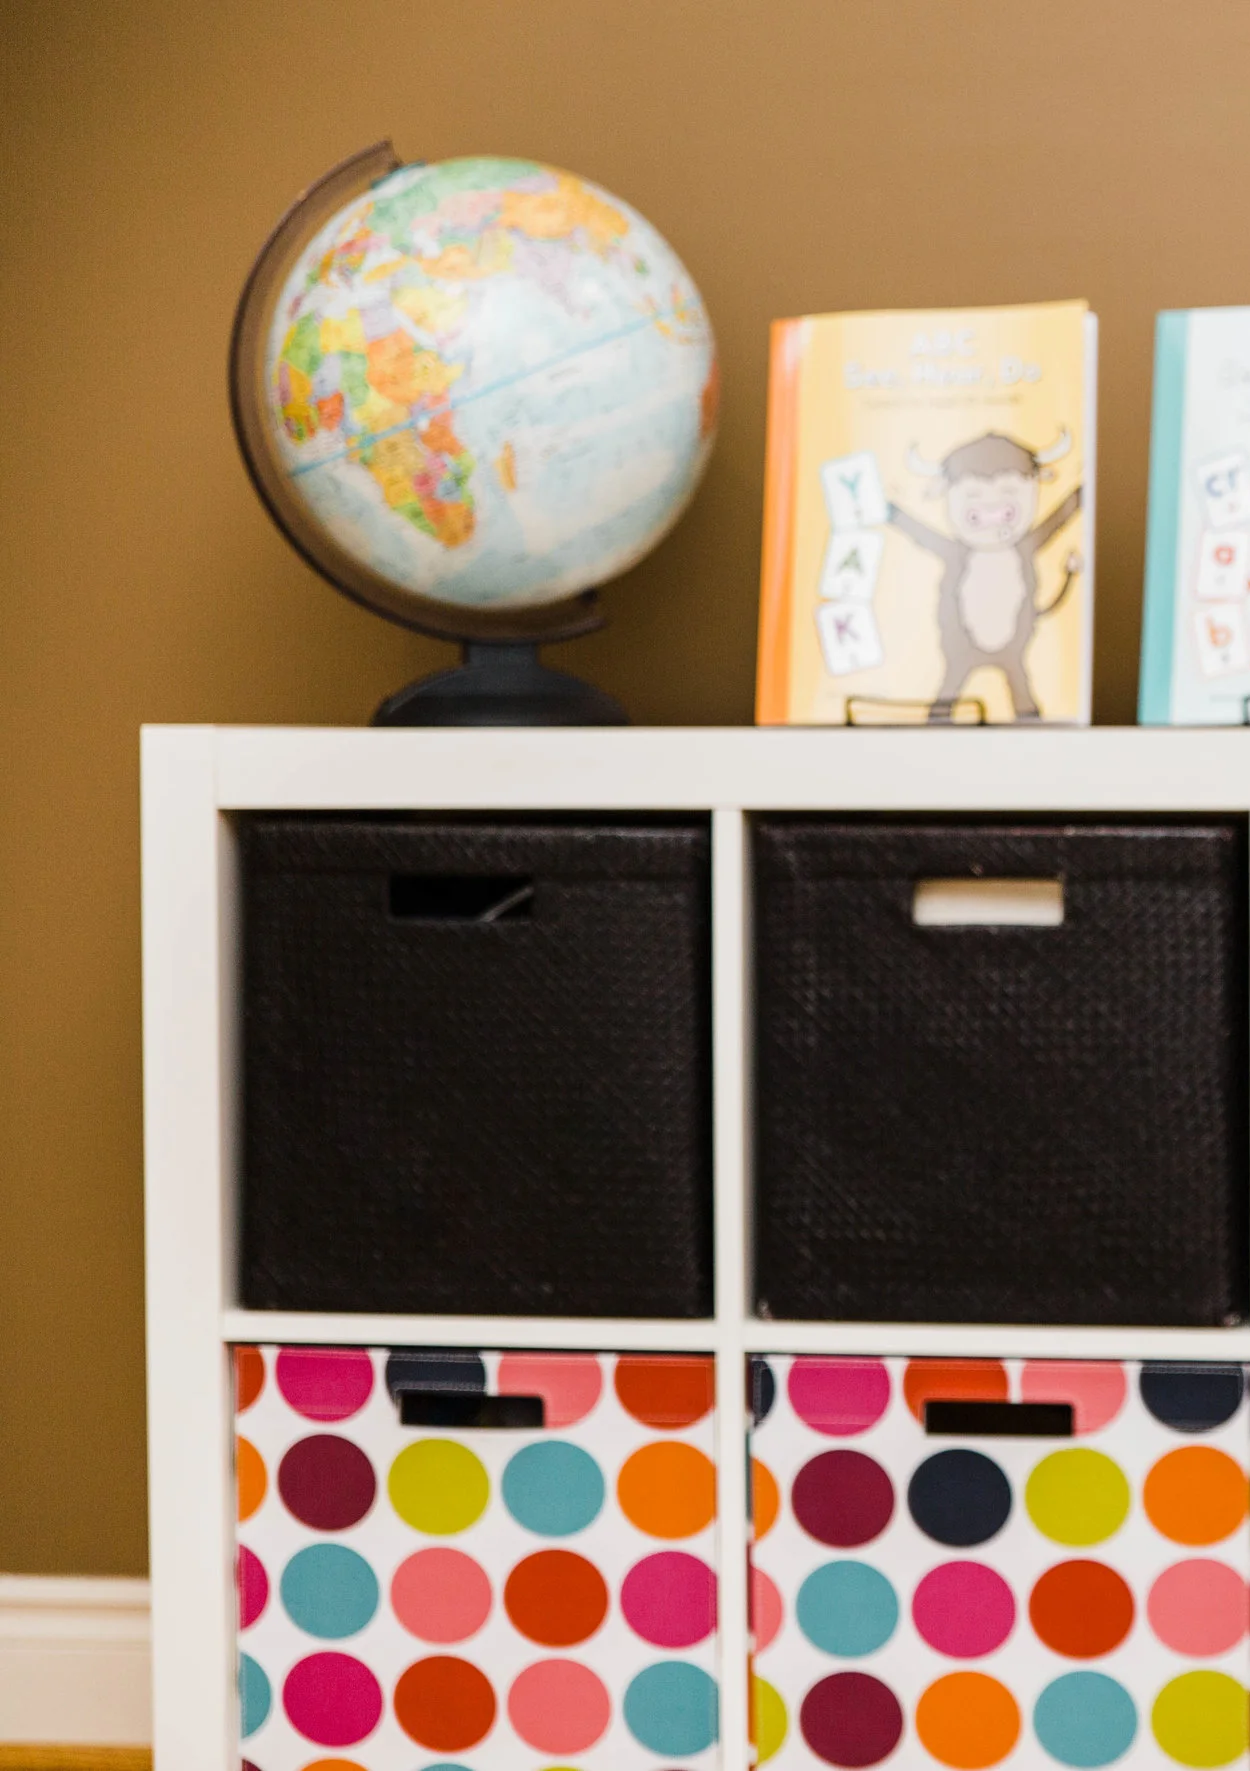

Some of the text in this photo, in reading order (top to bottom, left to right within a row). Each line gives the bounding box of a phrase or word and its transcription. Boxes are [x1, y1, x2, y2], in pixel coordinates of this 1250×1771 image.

[836, 470, 862, 500] Y
[835, 545, 864, 576] A
[1212, 543, 1236, 567] a
[832, 612, 860, 646] K
[1205, 616, 1233, 650] b
